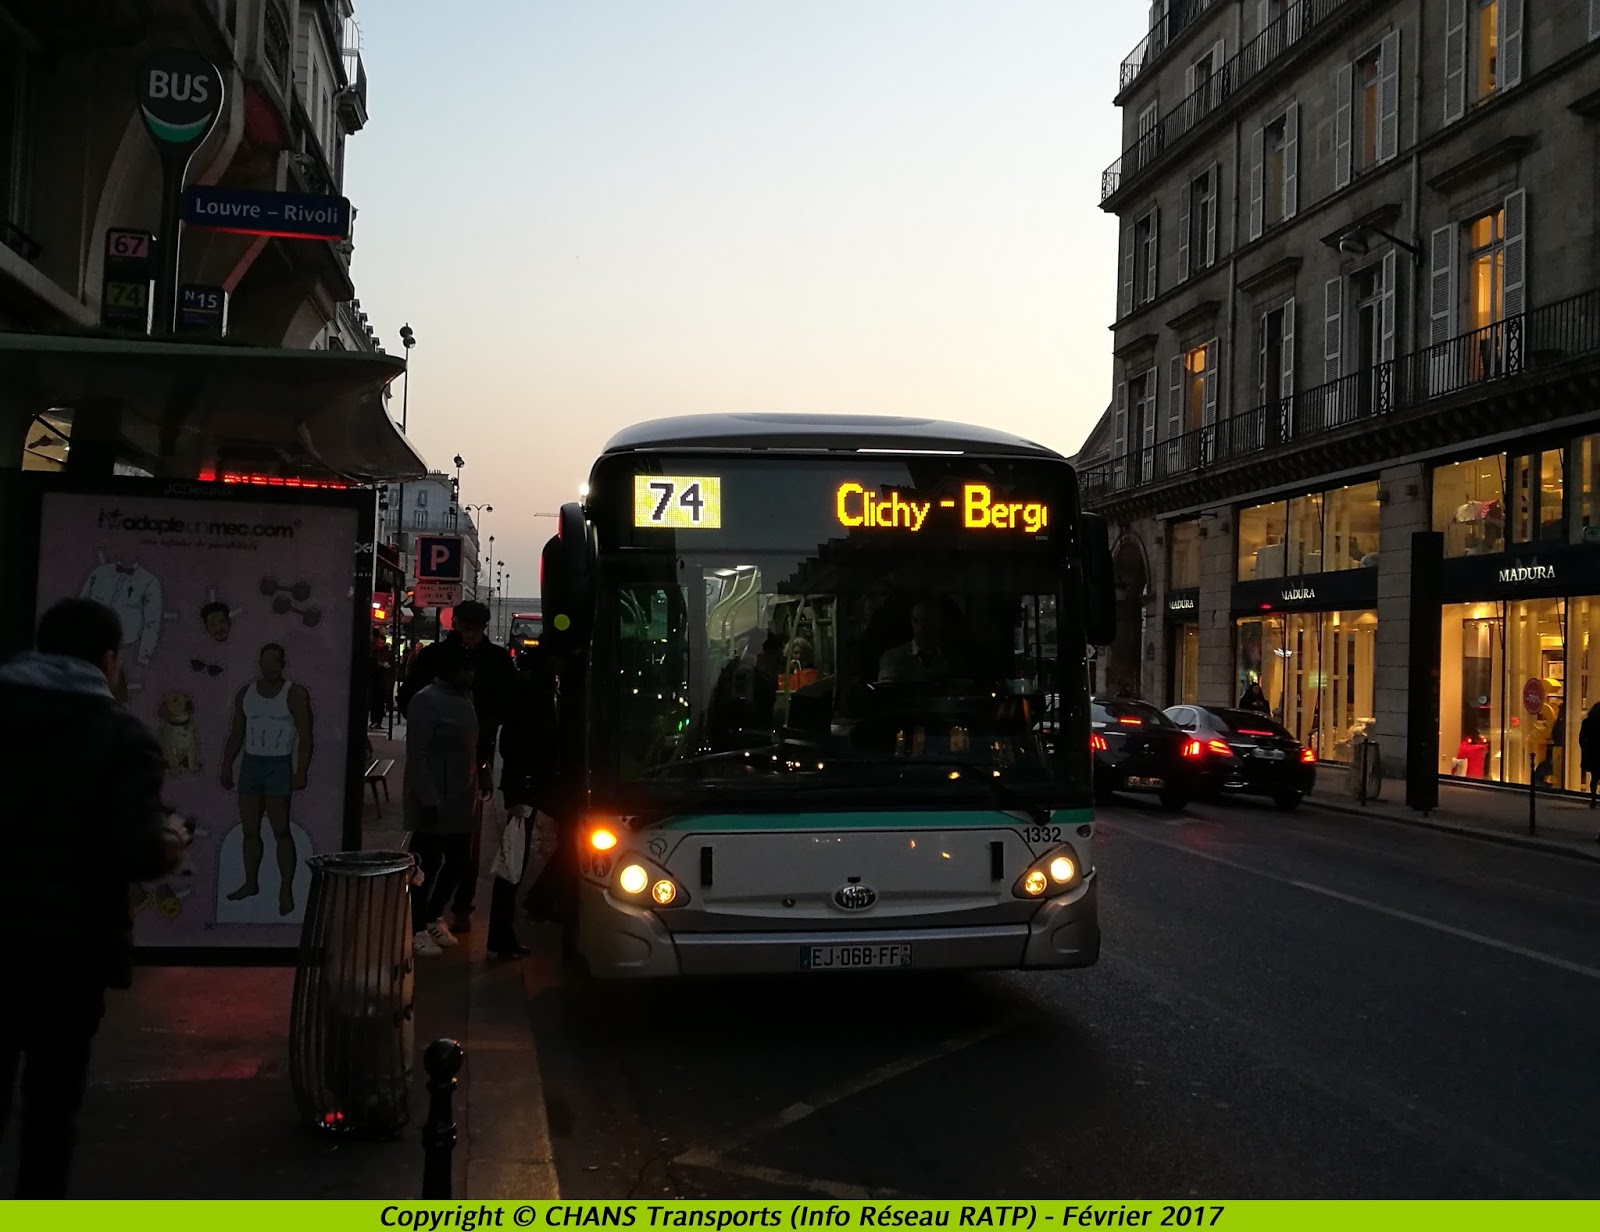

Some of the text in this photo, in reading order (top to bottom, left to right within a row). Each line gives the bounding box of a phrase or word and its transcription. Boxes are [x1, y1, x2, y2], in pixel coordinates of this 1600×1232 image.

[148, 69, 209, 103] BUS
[195, 197, 261, 218] Louvre
[284, 204, 339, 224] Rivoli
[114, 235, 143, 255] 67
[111, 284, 140, 305] 74
[649, 482, 704, 521] 74
[836, 483, 930, 532] Clichy
[430, 544, 451, 571] P
[1498, 564, 1556, 583] MADURA
[1168, 599, 1194, 610] MADURA
[1281, 588, 1315, 601] MADURA
[1023, 827, 1062, 843] 1332
[812, 946, 900, 966] EJ-068-FF
